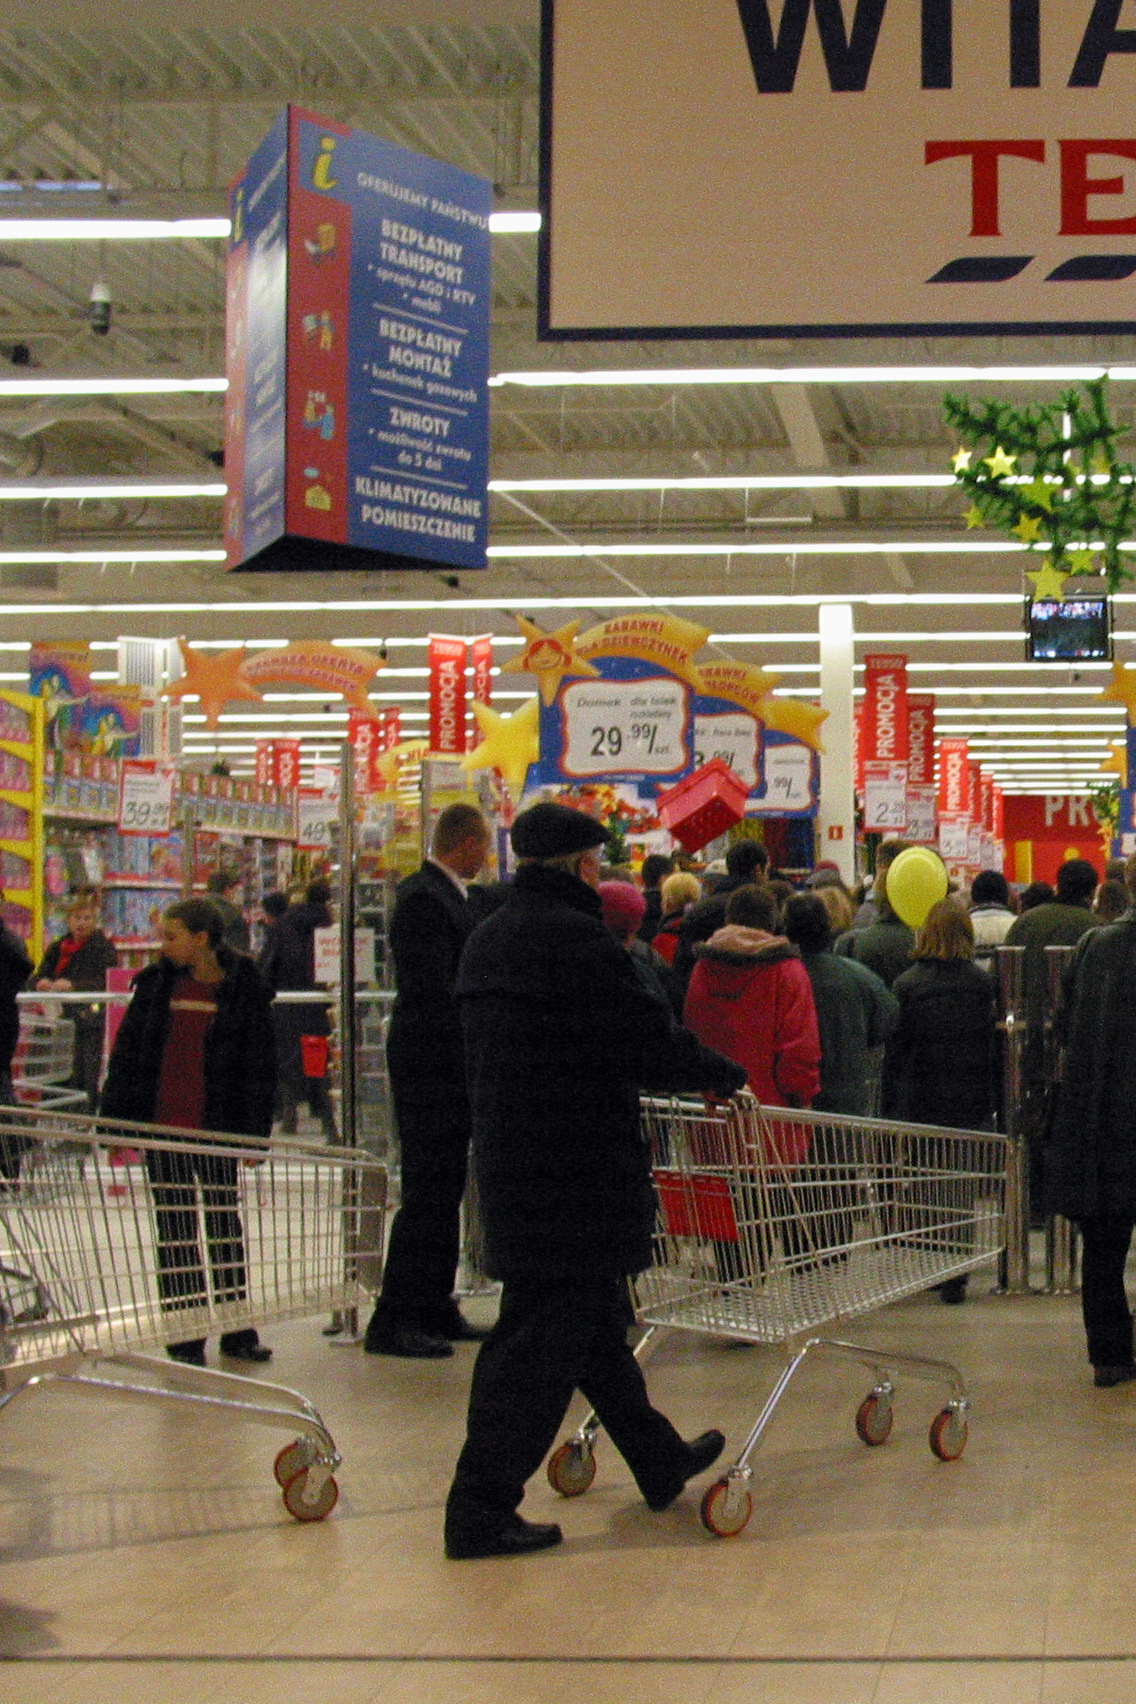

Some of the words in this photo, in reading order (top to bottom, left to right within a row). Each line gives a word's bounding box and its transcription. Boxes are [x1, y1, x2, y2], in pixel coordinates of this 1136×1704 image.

[381, 218, 464, 262] BEZPŁATNY
[380, 241, 464, 285] TRANSPORT
[453, 287, 477, 306] RTV
[379, 317, 463, 357] BEZPŁATNY
[388, 345, 453, 378] MONTAŻ
[389, 406, 451, 438] ZWROTY
[355, 475, 482, 519] KLIMATYZOWANE
[361, 503, 477, 543] POMIESZCZENIE
[605, 620, 665, 633] ZABAWKI
[438, 659, 460, 750] PROMOCJA
[876, 674, 900, 759] PROMOCJA
[909, 708, 930, 782] PROMOCJA
